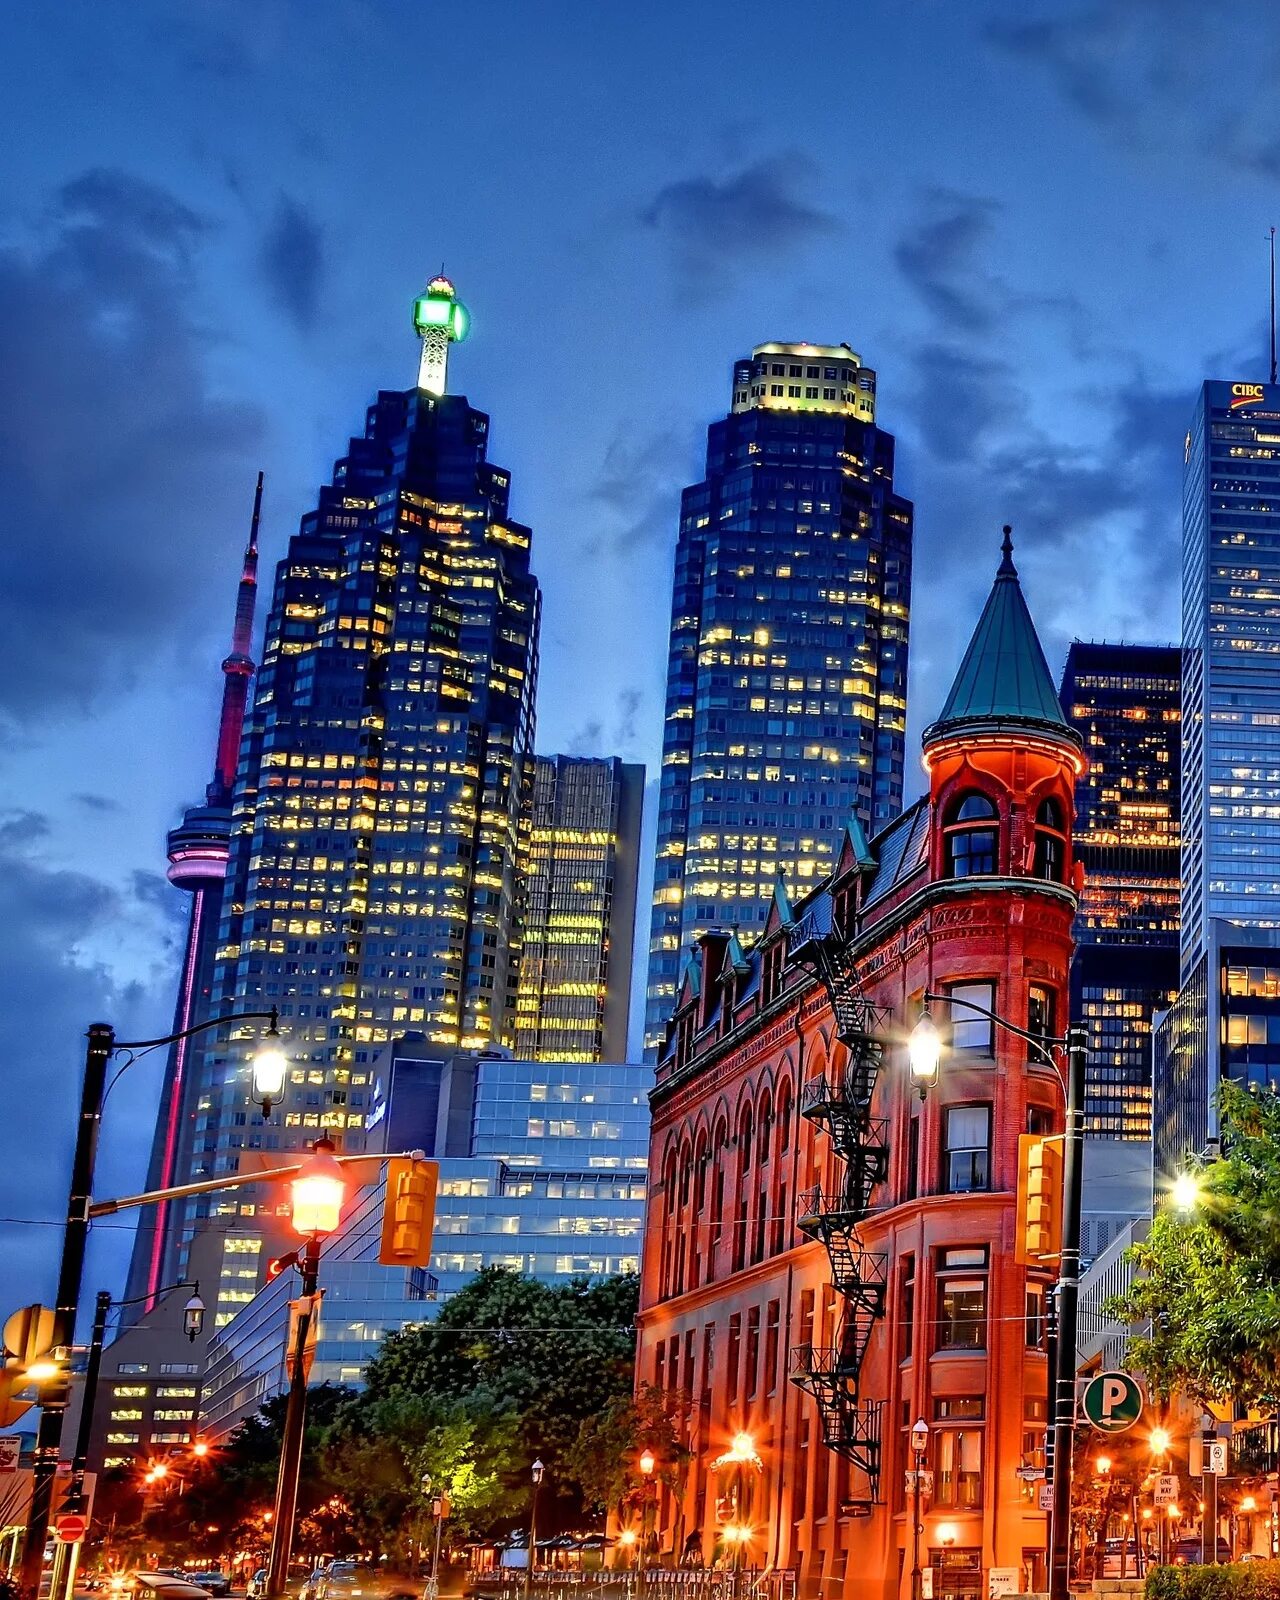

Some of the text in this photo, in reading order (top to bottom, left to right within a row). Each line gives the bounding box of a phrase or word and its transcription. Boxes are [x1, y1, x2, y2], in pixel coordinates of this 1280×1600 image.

[1231, 384, 1264, 397] CIBC
[1102, 1378, 1127, 1416] P
[1160, 1477, 1172, 1486] ONE
